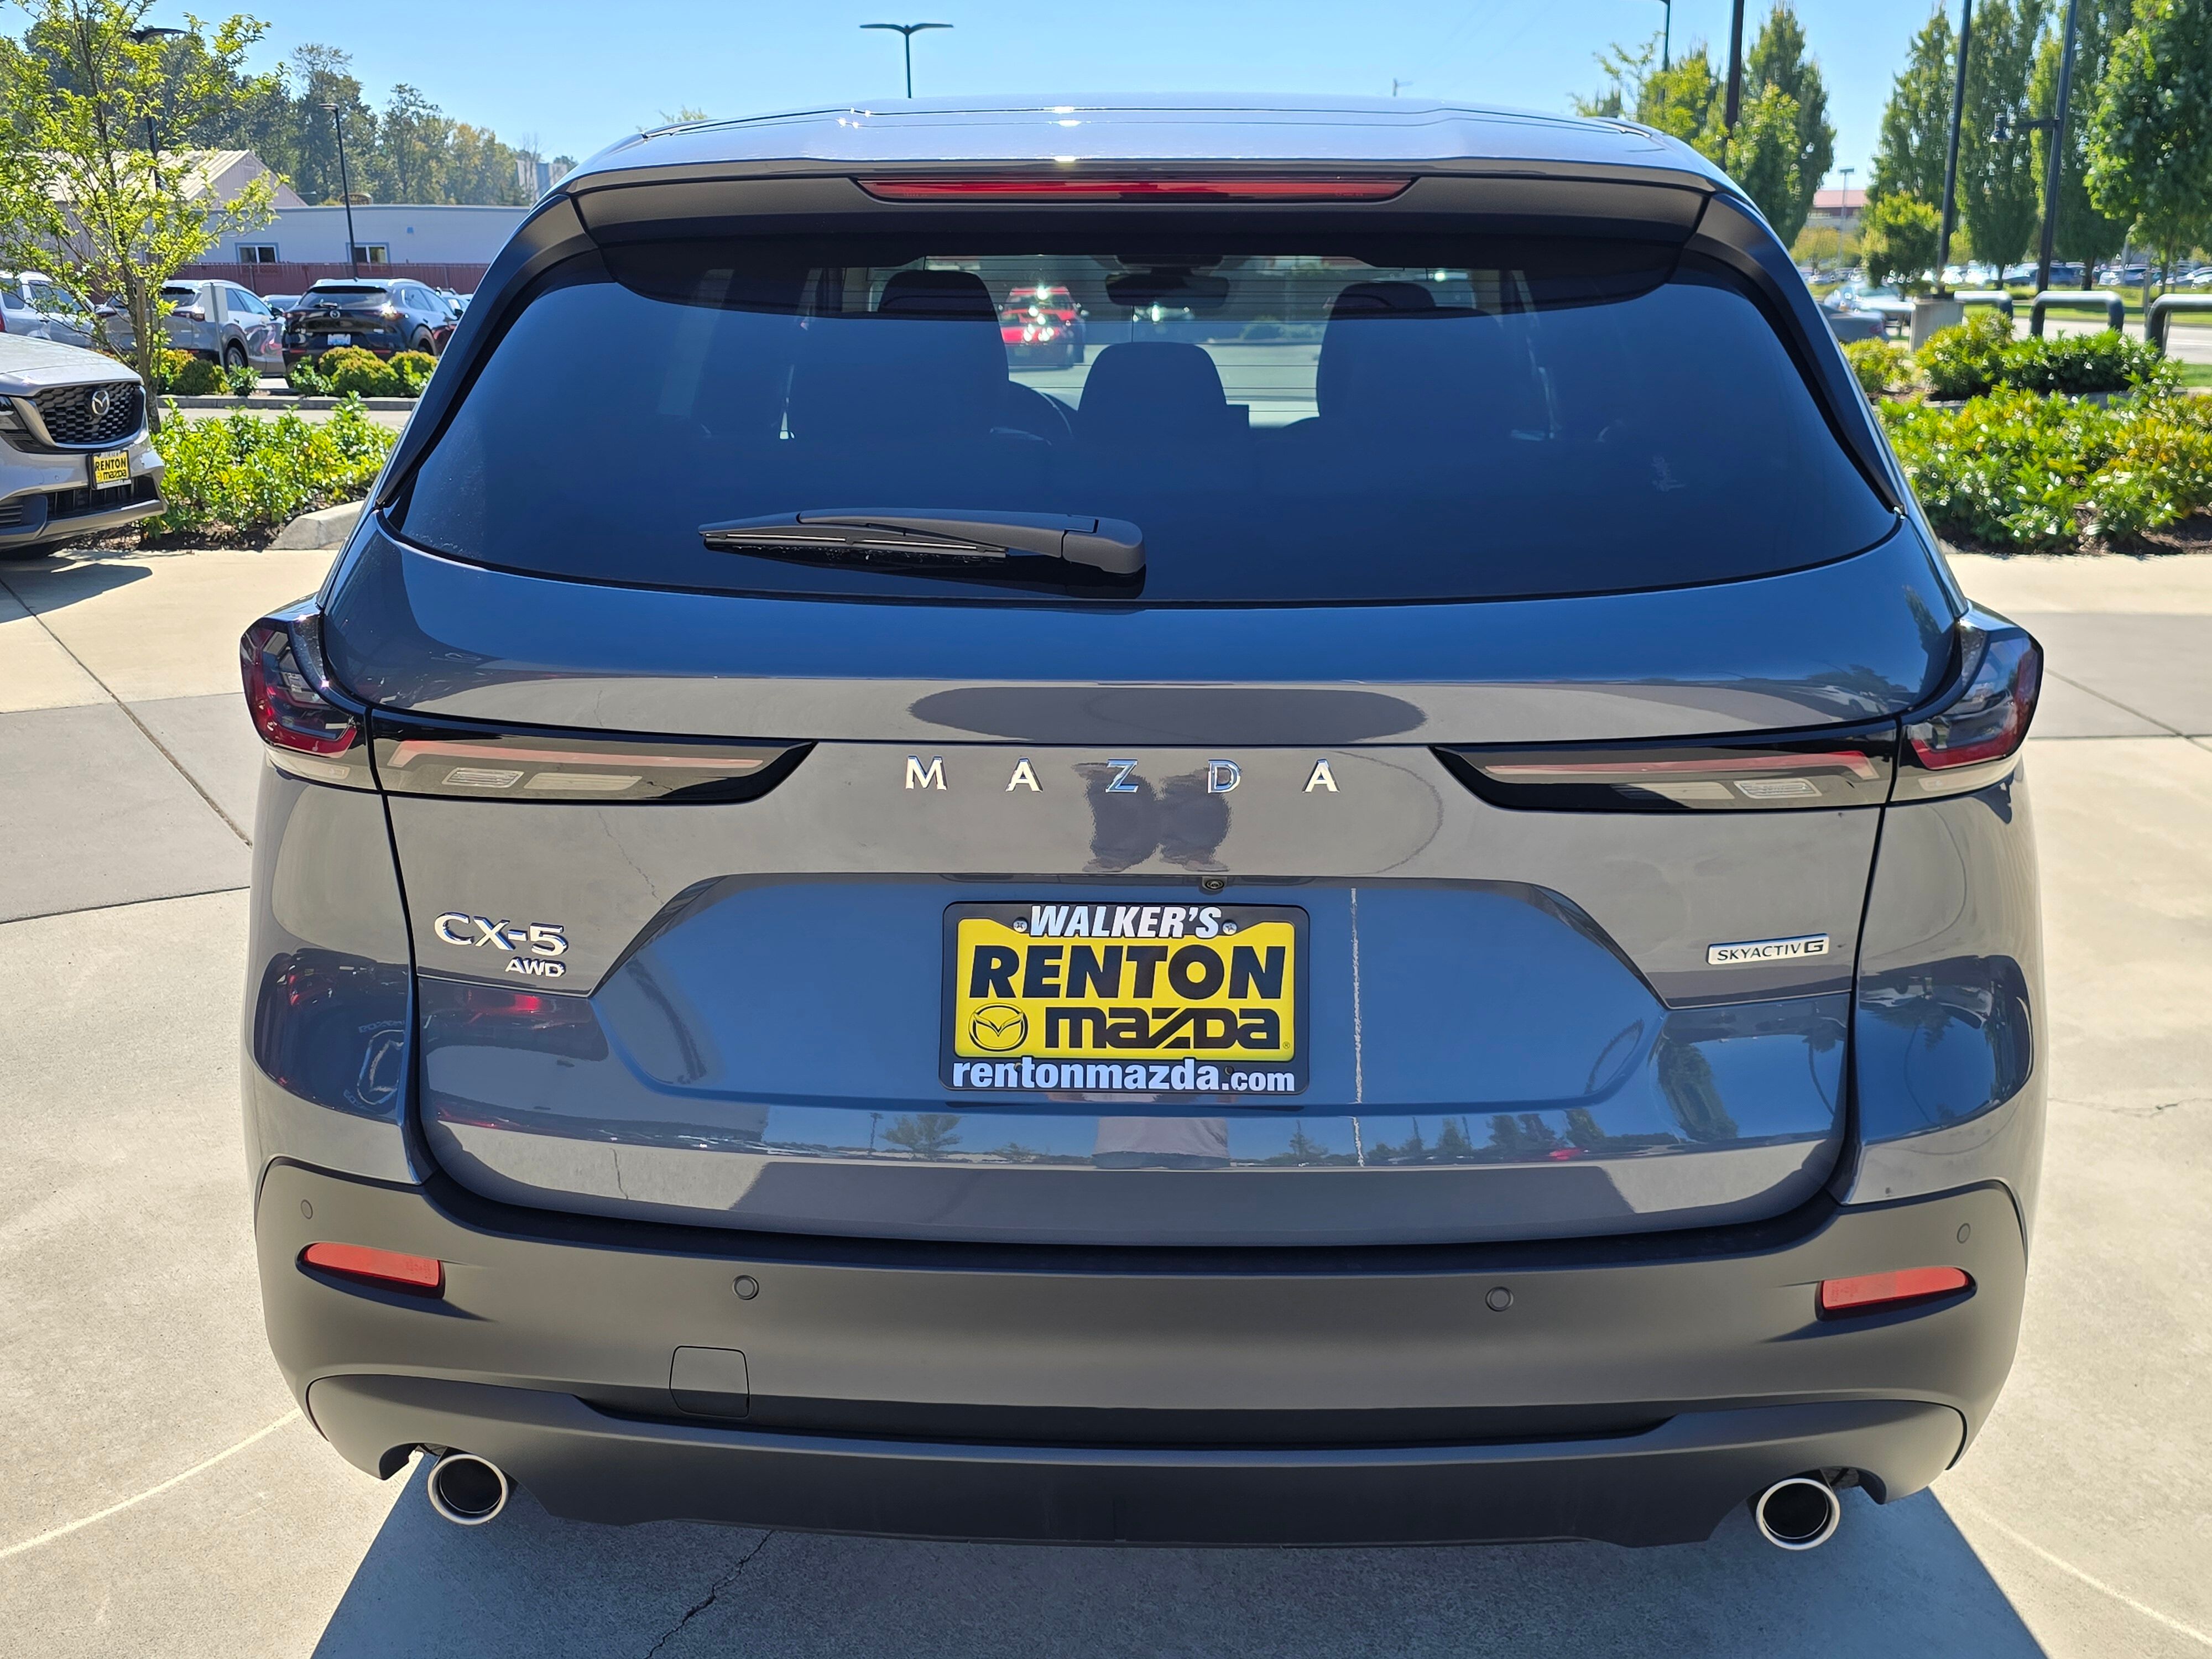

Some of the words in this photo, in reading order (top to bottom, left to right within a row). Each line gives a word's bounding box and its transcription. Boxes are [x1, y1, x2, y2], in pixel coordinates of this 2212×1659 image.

[95, 458, 126, 471] RENTON
[905, 755, 1340, 793] MAZDA
[434, 911, 568, 956] CX-5
[1029, 905, 1222, 939] WALKER'S
[505, 956, 566, 977] AWD
[969, 944, 1286, 1000] RENTON
[952, 1057, 1295, 1092] rentonmazda.com
